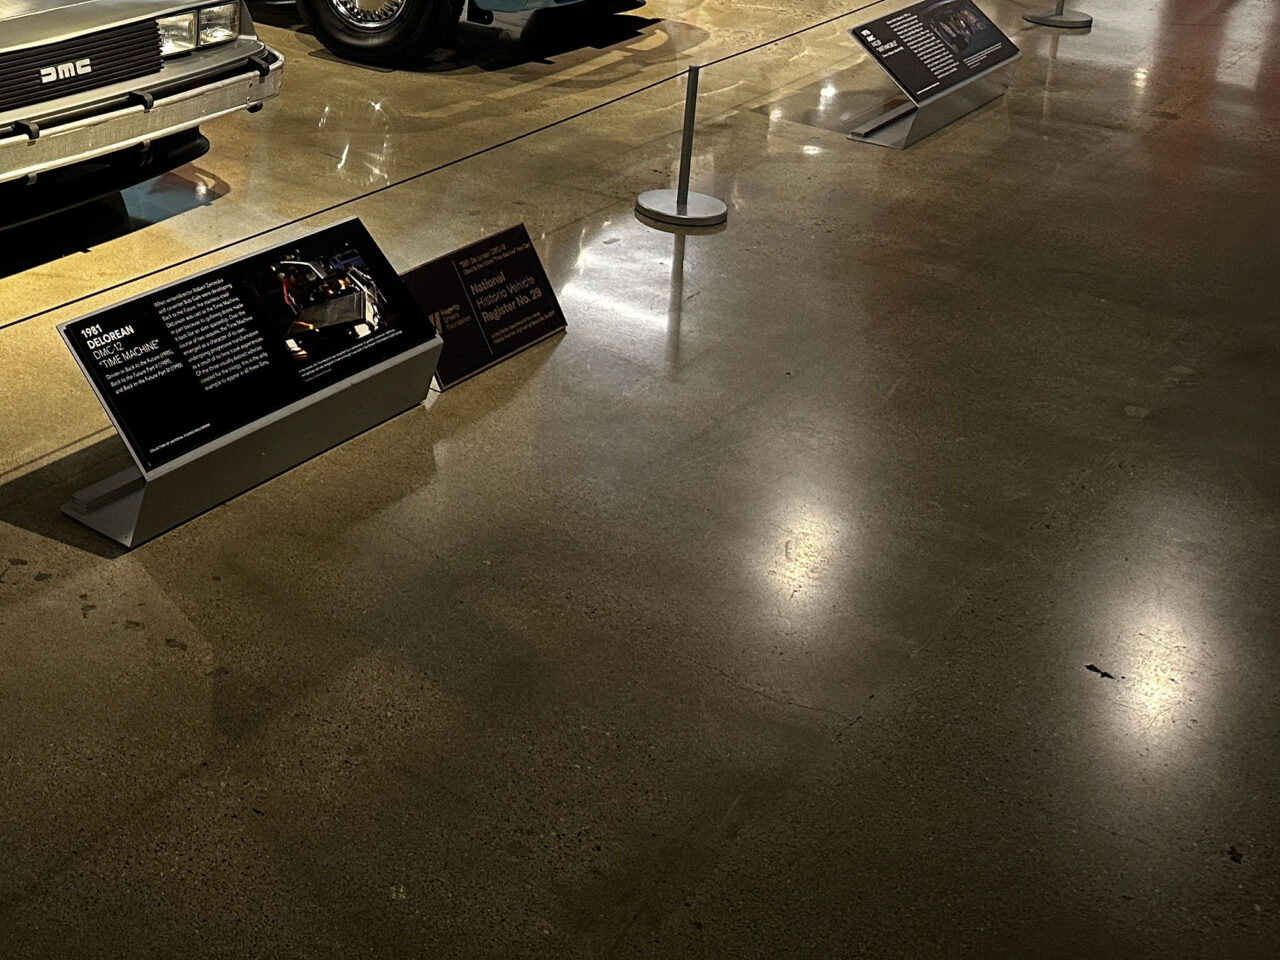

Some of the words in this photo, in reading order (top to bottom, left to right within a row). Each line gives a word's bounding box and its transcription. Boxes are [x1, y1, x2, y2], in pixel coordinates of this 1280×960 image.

[470, 272, 506, 295] National
[476, 289, 507, 309] Historic
[506, 276, 535, 294] Vehicle
[481, 301, 515, 323] Register
[516, 295, 531, 306] No.
[530, 287, 542, 300] 29
[81, 324, 102, 338] 1981
[87, 325, 134, 349] DELOREAN
[93, 342, 124, 360] DMC-12
[99, 355, 123, 368] "TIME
[122, 339, 159, 361] MACHINE"
